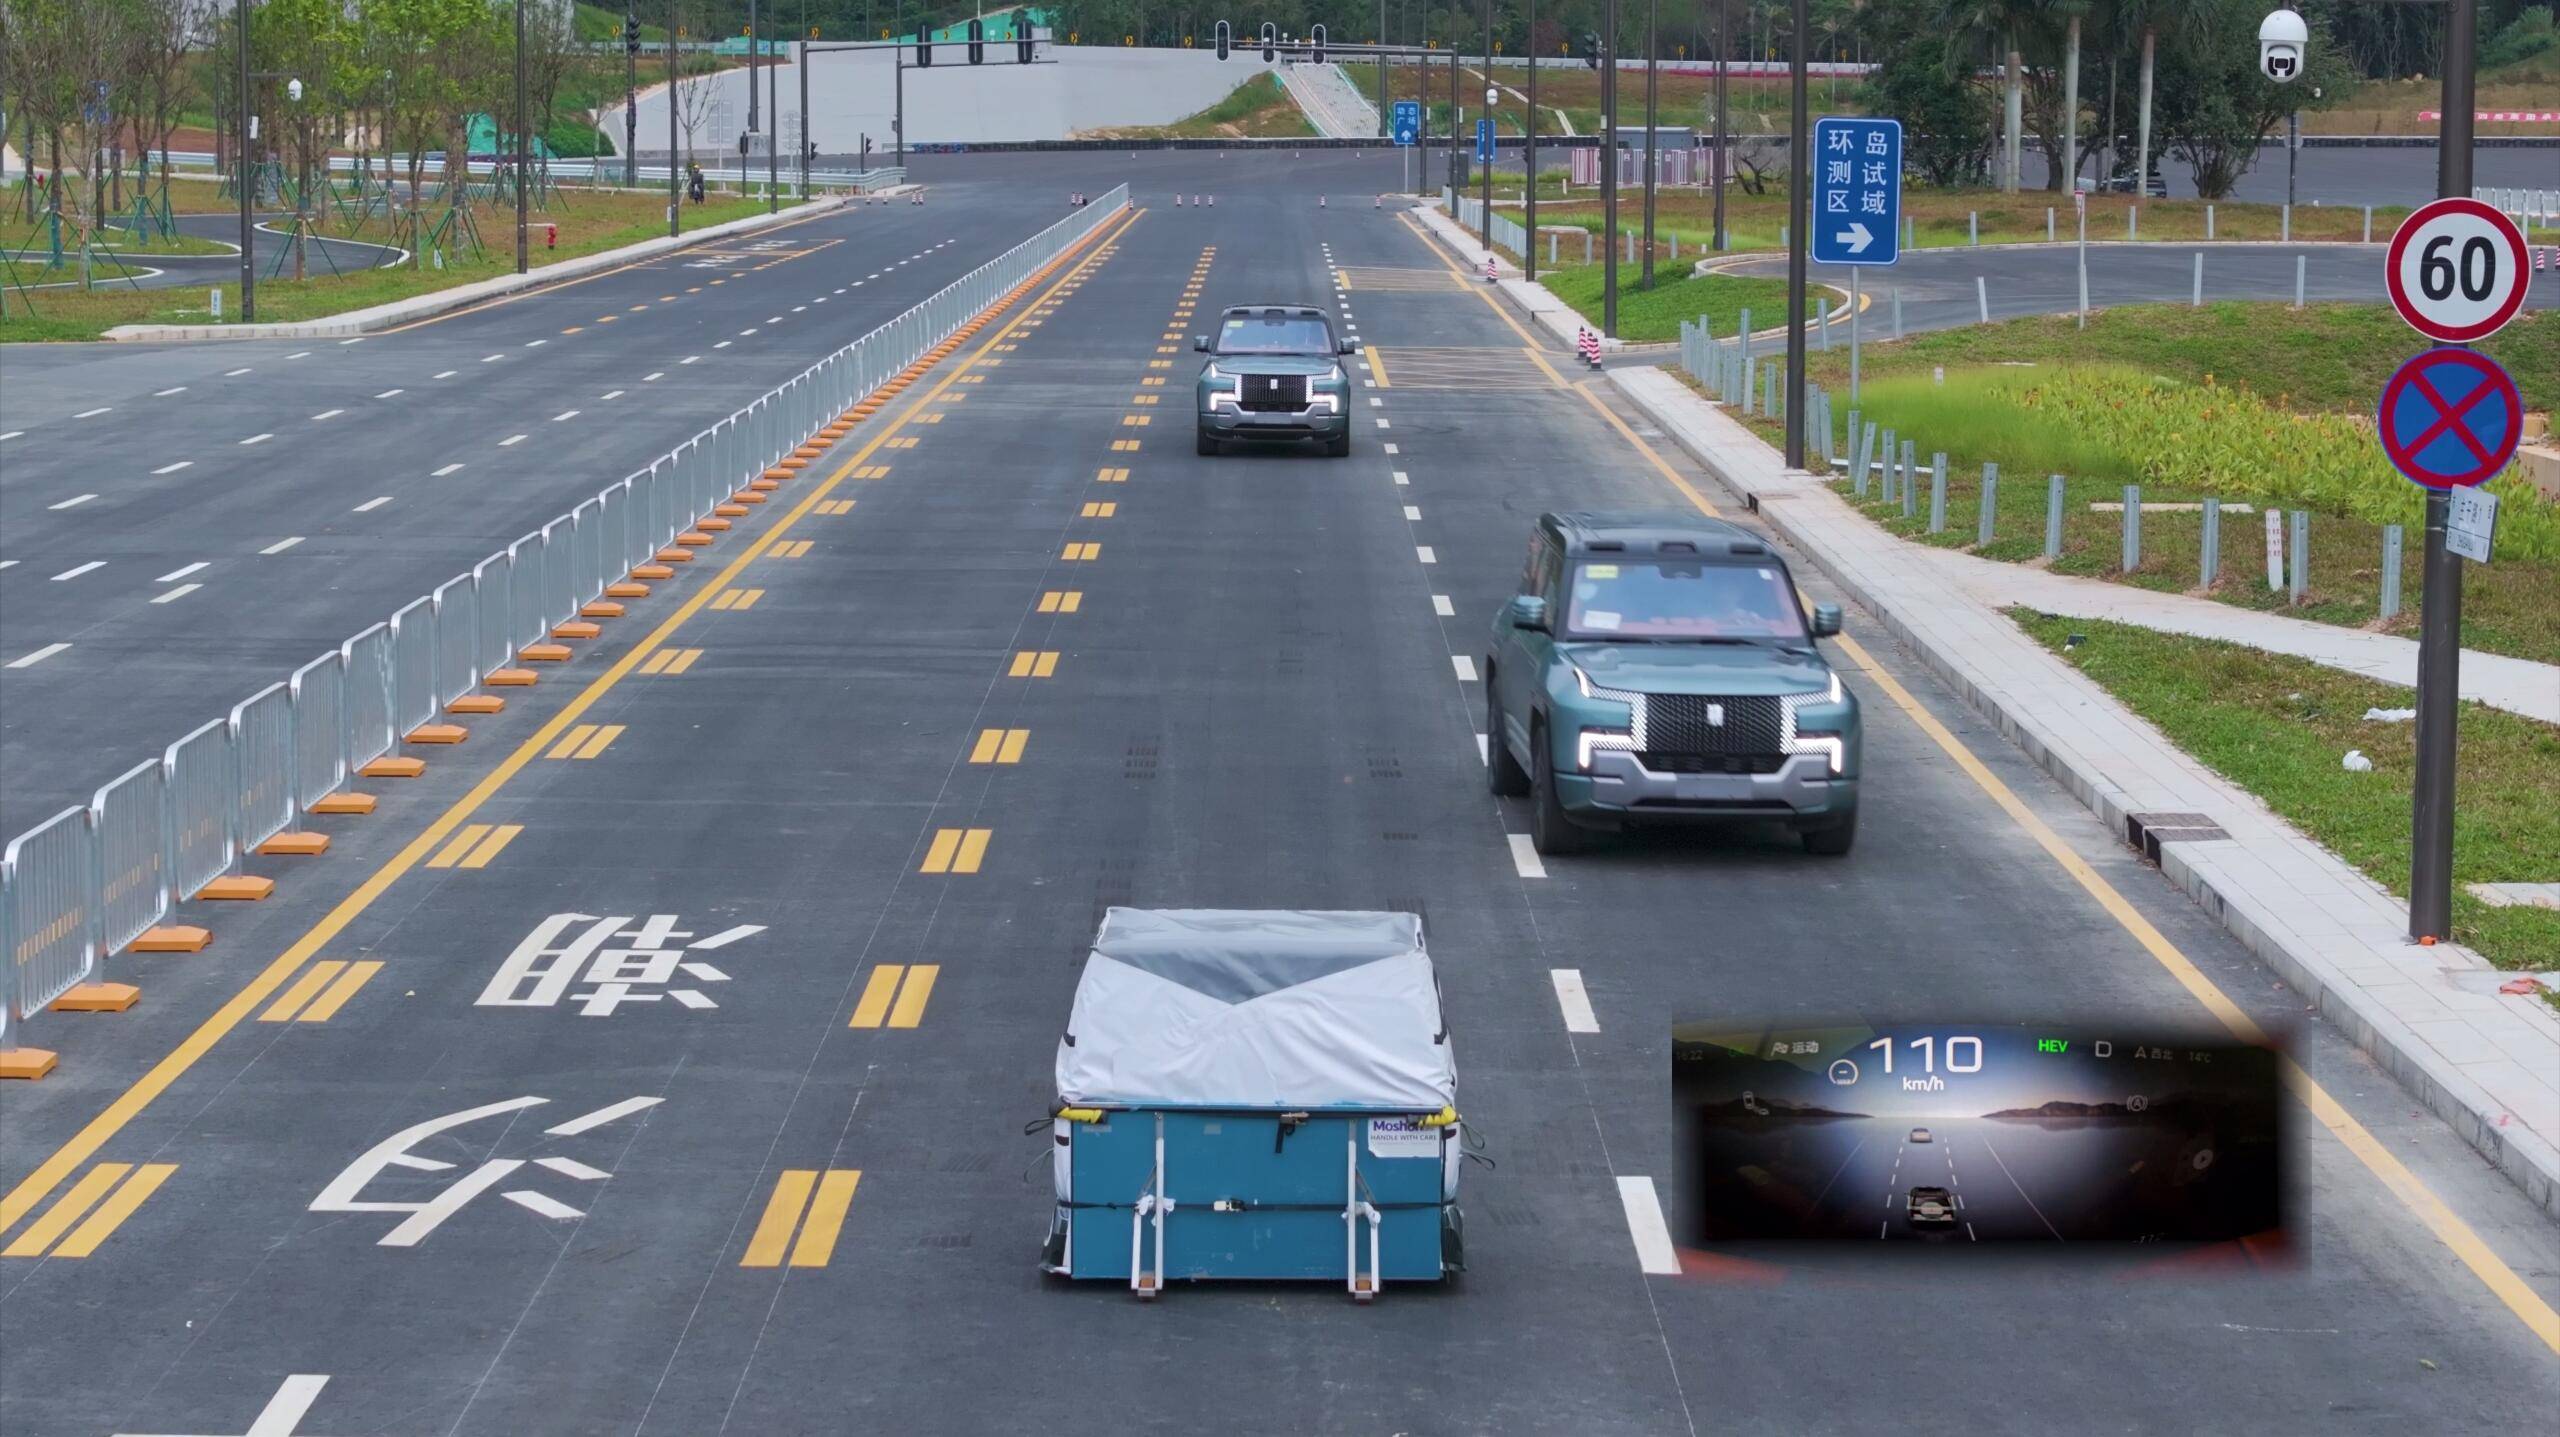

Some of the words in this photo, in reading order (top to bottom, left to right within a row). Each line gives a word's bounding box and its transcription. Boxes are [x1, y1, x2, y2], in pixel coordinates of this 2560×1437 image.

[1828, 130, 1888, 155] 环岛
[1827, 160, 1886, 185] 测试
[1827, 190, 1886, 215] 区域
[2420, 235, 2496, 302] 60
[1870, 1036, 1982, 1074] 110
[2038, 1039, 2068, 1053] HEV
[2095, 1041, 2112, 1057] D
[1902, 1075, 1945, 1093] km/h
